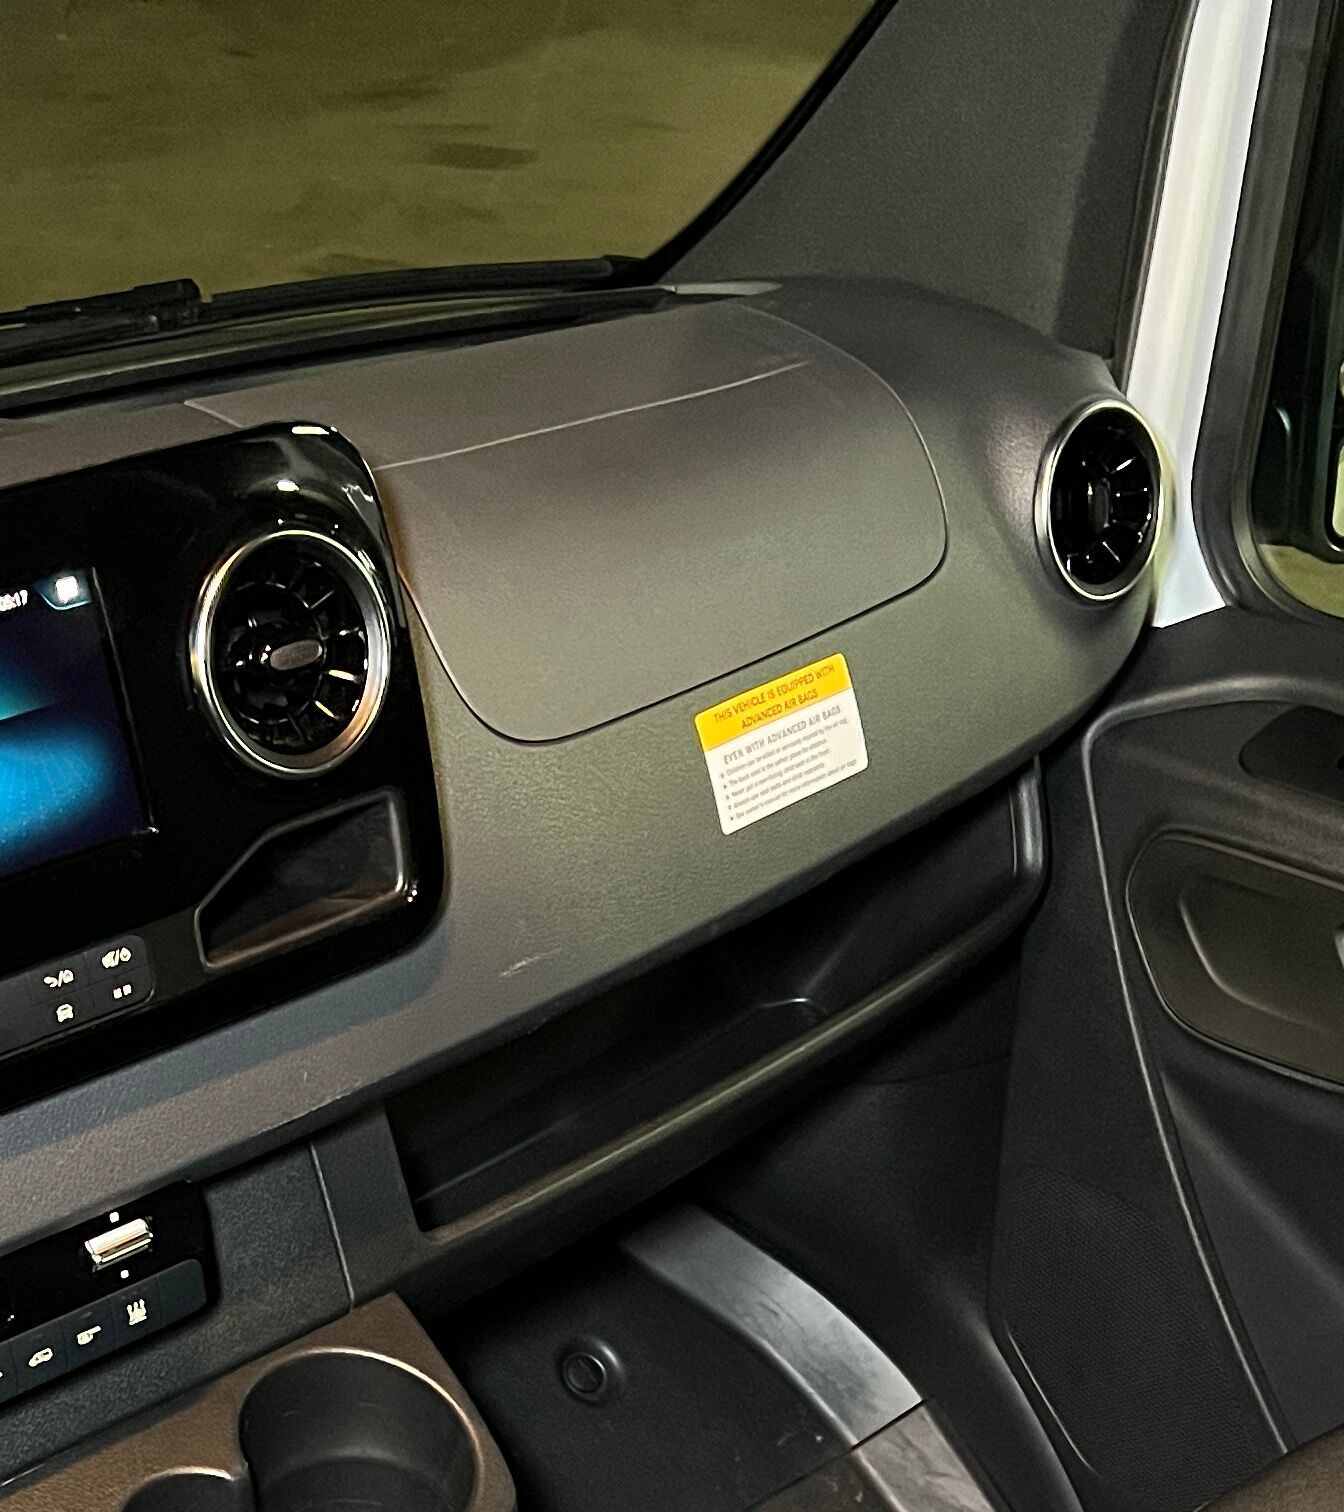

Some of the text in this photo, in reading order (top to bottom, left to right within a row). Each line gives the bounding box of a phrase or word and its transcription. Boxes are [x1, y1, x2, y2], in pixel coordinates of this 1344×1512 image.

[714, 665, 835, 723] THIS VEHICLE IS EQUIPPED WITH
[741, 689, 819, 729] ADVANCED AIR BAGS
[723, 705, 841, 765] EVEN WITH ADVANCED AIR BAGS
